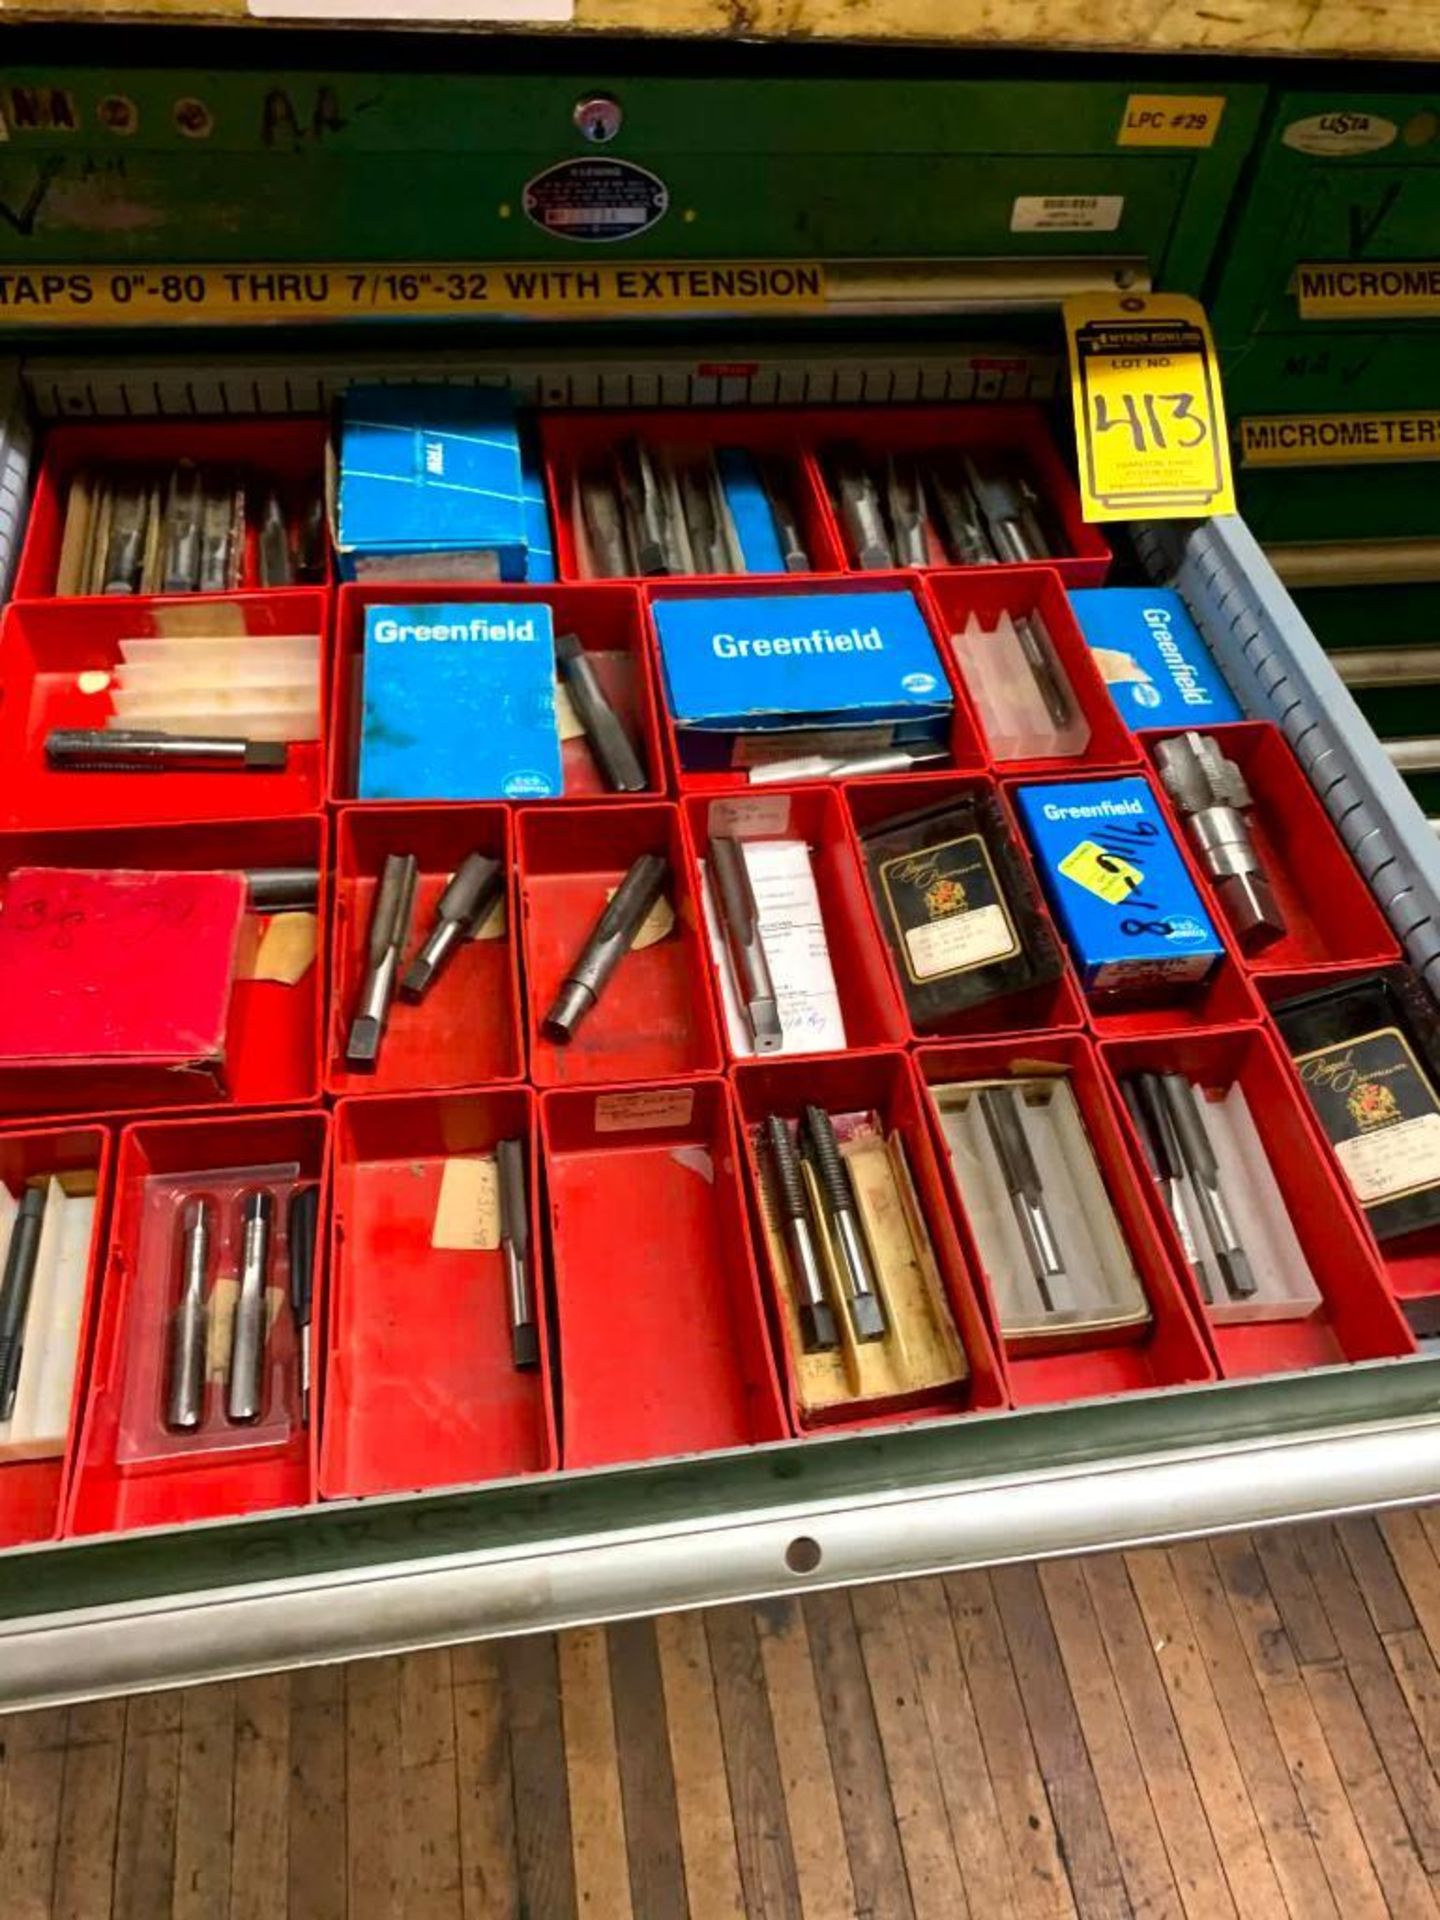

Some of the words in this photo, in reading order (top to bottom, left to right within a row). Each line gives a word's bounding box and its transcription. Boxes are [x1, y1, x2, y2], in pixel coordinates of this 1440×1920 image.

[1127, 111, 1166, 129] LPC
[1170, 113, 1208, 130] #29
[0, 274, 93, 305] TAPS
[109, 274, 206, 304] 0"-80
[223, 273, 329, 302] THRU
[502, 271, 600, 300] WITH
[614, 268, 820, 299] EXTENSION
[1111, 357, 1142, 370] LOT
[1093, 392, 1208, 453] 413
[1245, 420, 1440, 449] MICROMETER
[374, 619, 536, 644] Greenfield
[712, 627, 884, 659] Greenfield
[1142, 608, 1214, 705] Greenfield
[1042, 799, 1144, 821] Greenfield
